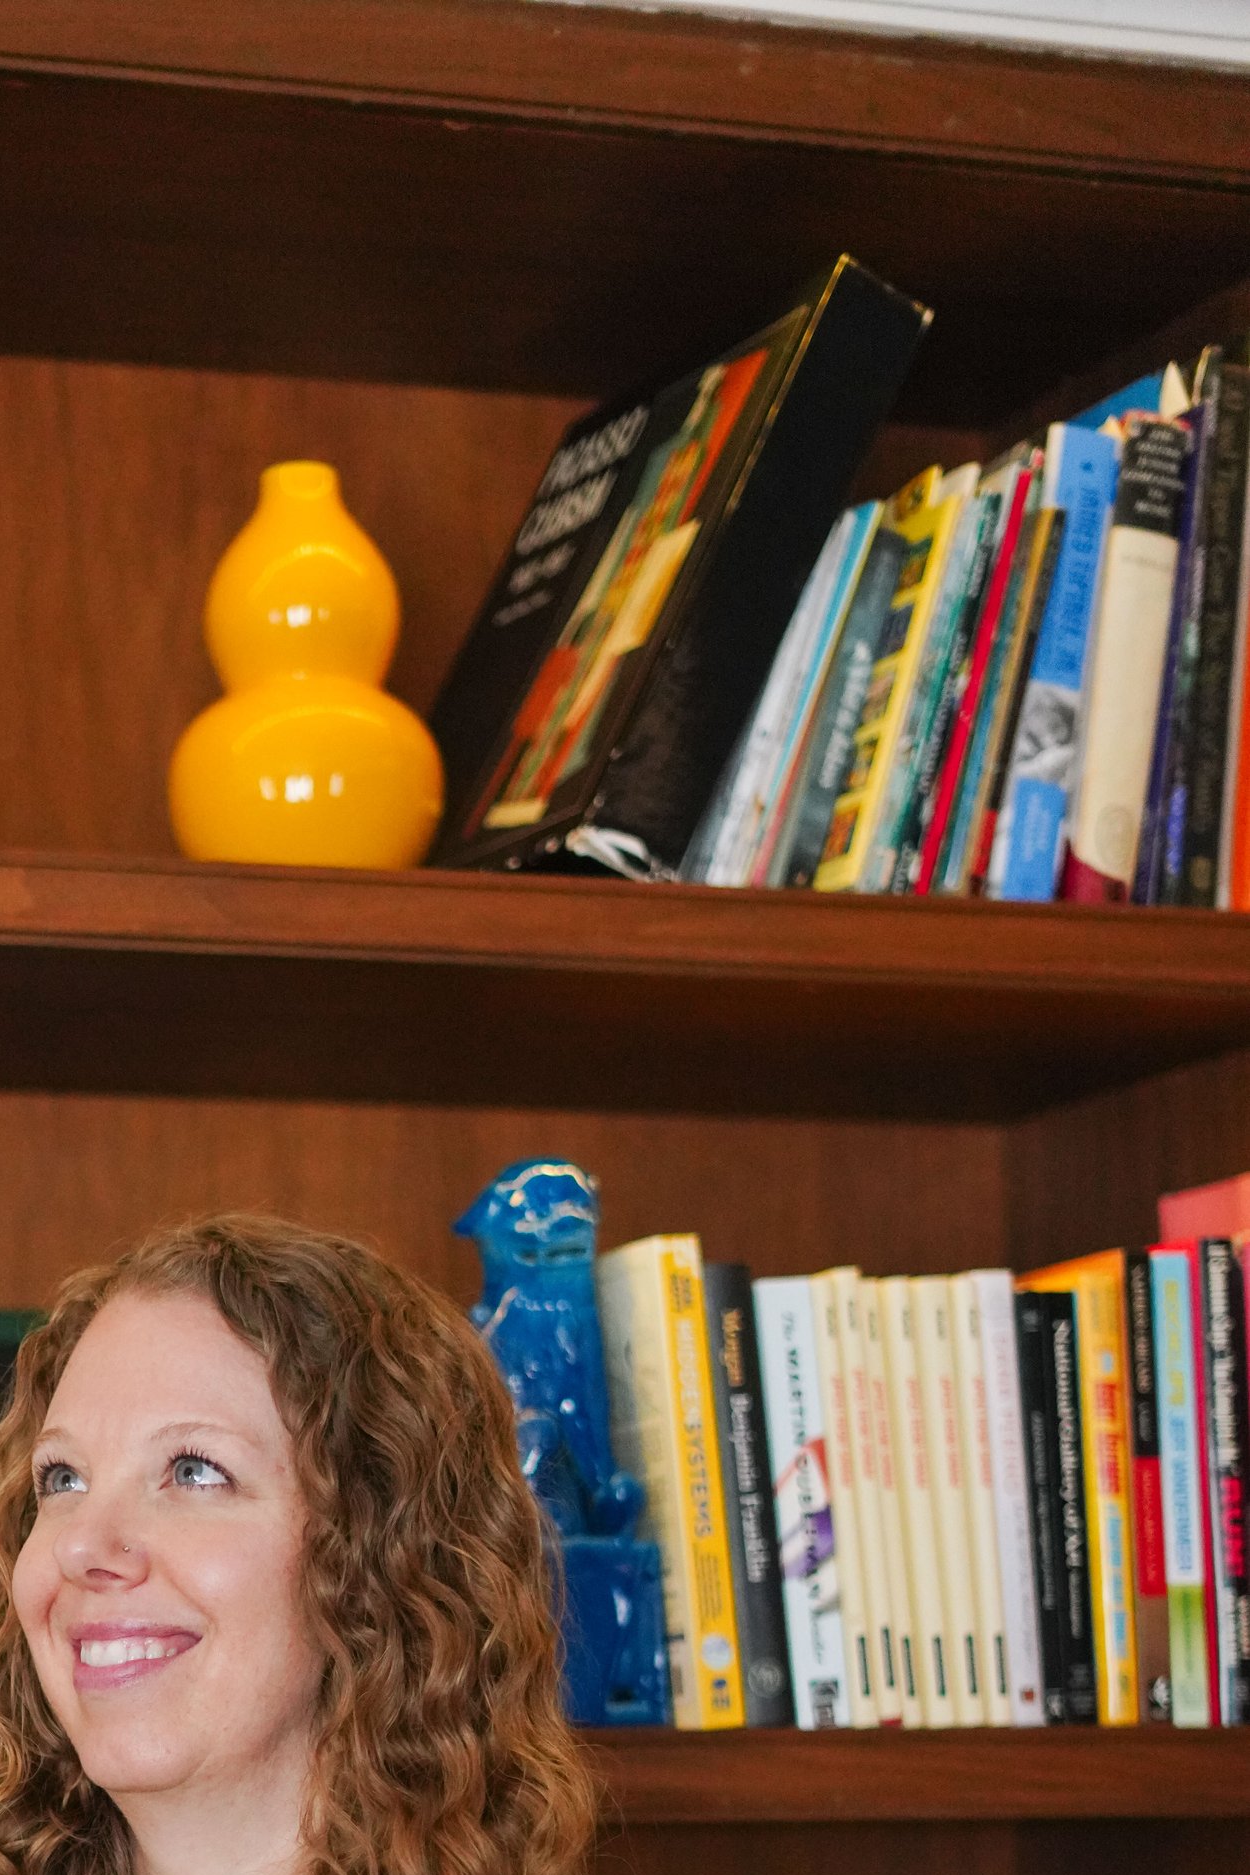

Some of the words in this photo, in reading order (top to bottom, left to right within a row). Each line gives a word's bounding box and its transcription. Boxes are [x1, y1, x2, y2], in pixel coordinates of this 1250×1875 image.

[729, 1391, 759, 1492] Benjamin
[784, 1346, 808, 1446] MARTIN
[684, 1420, 713, 1539] SYSTEMS
[738, 1492, 771, 1583] Franklin
